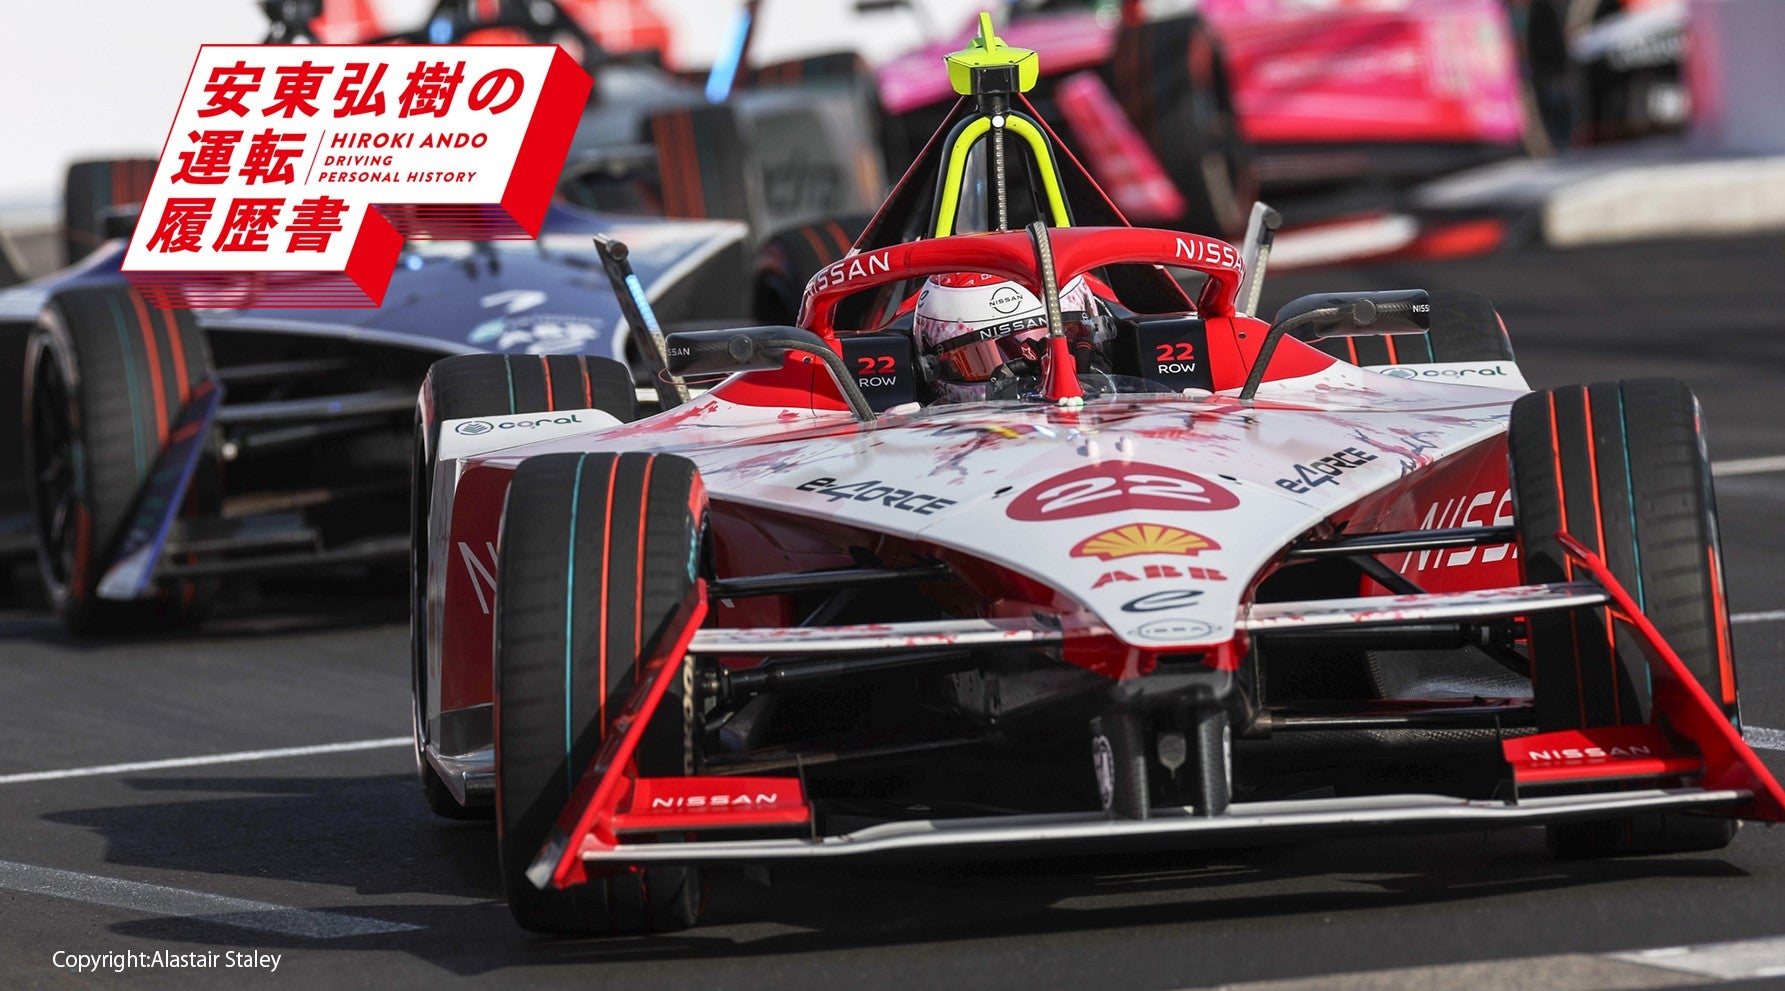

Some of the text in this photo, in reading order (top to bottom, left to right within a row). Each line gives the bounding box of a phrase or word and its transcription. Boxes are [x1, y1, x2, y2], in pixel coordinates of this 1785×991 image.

[989, 294, 1024, 307] NISSAN
[1156, 343, 1195, 361] 22
[857, 356, 896, 374] 22
[1158, 363, 1196, 374] ROW
[1422, 365, 1508, 378] coral
[858, 376, 897, 388] ROW
[498, 414, 583, 429] coral
[1036, 474, 1212, 513] 22
[1091, 565, 1228, 589] ABB
[1529, 746, 1650, 761] NISSAN
[652, 793, 777, 808] NISSAN
